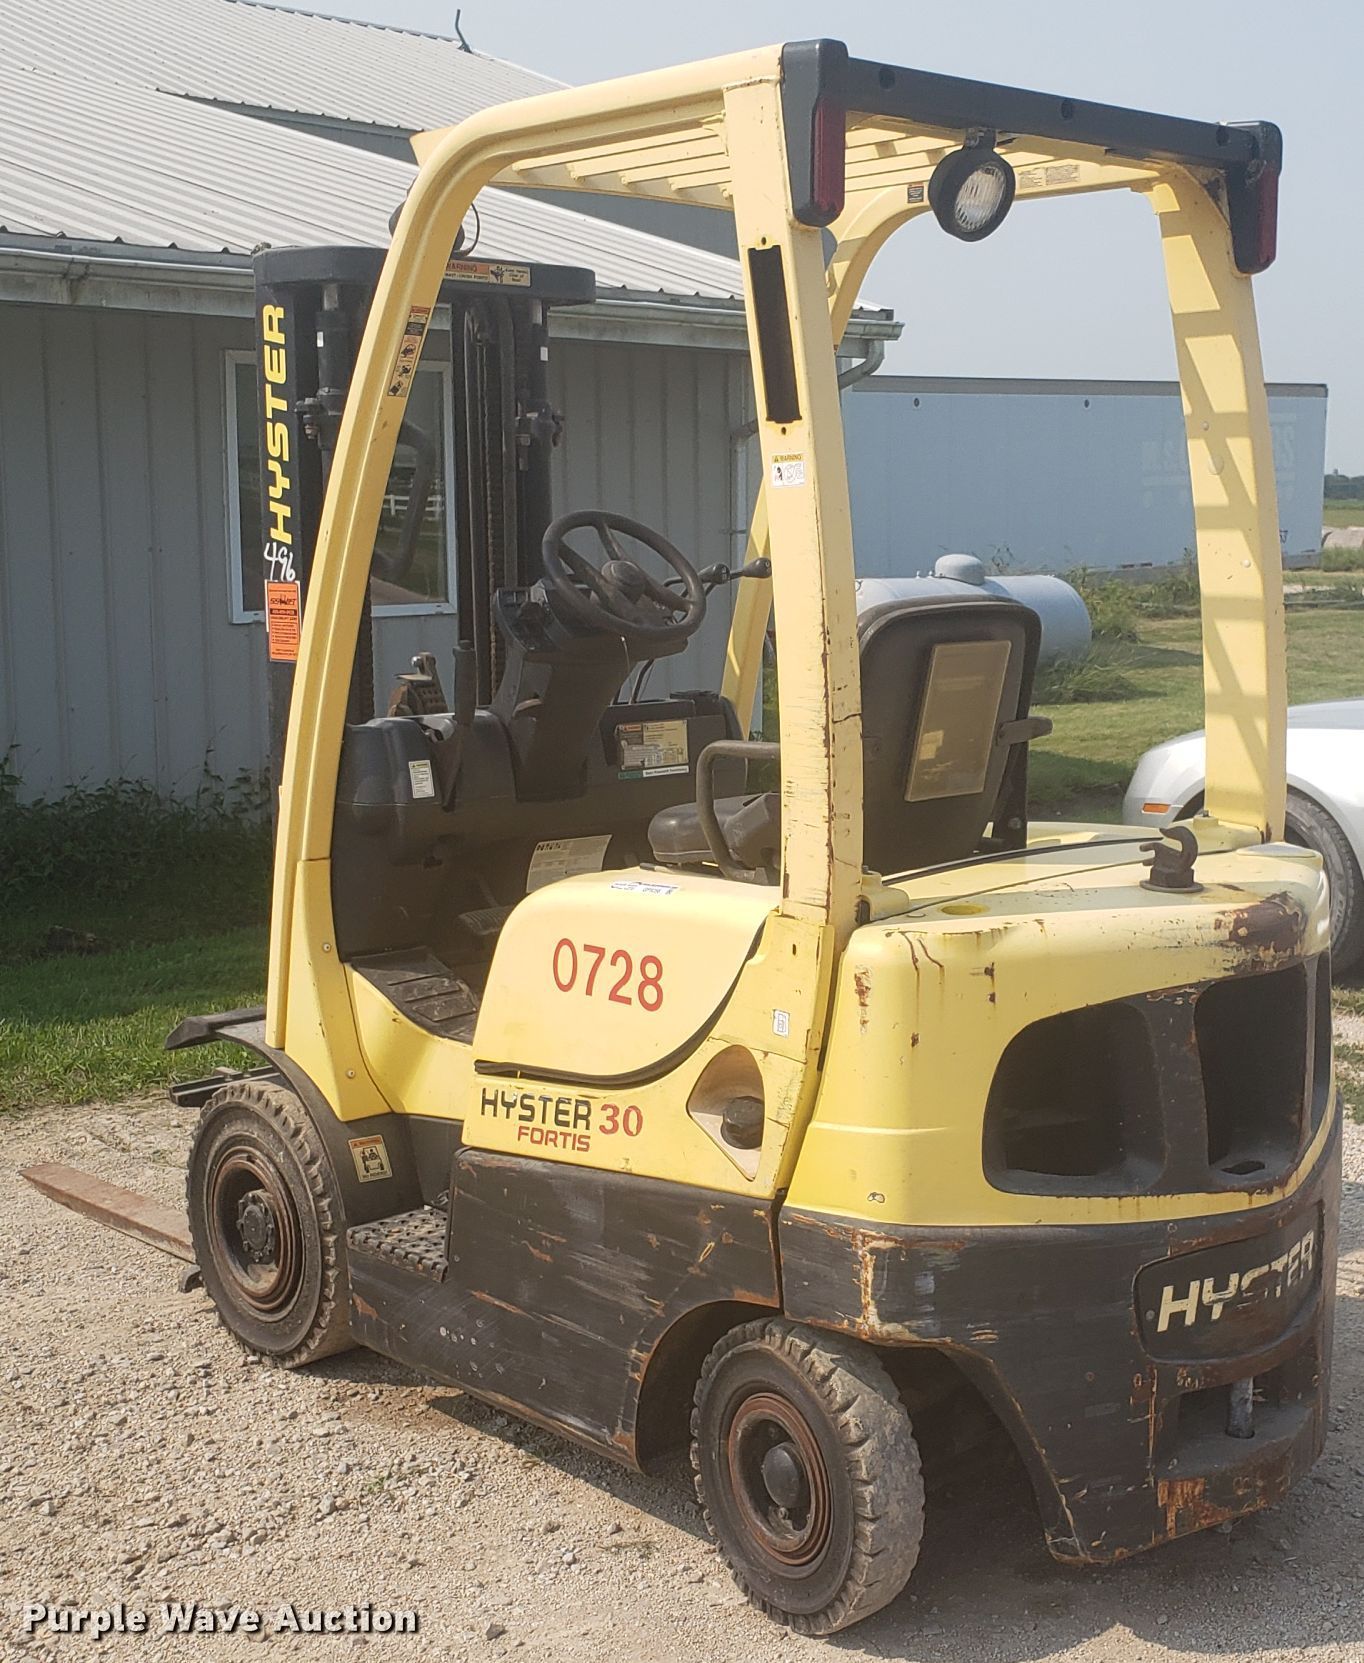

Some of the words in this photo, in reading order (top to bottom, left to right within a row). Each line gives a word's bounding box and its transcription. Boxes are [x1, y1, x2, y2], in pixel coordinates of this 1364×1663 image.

[262, 304, 292, 544] HYSTER
[263, 541, 296, 582] 496
[552, 937, 664, 1012] 0728
[480, 1087, 592, 1131] HYSTER
[599, 1102, 644, 1137] 30
[517, 1125, 591, 1153] FORTIS
